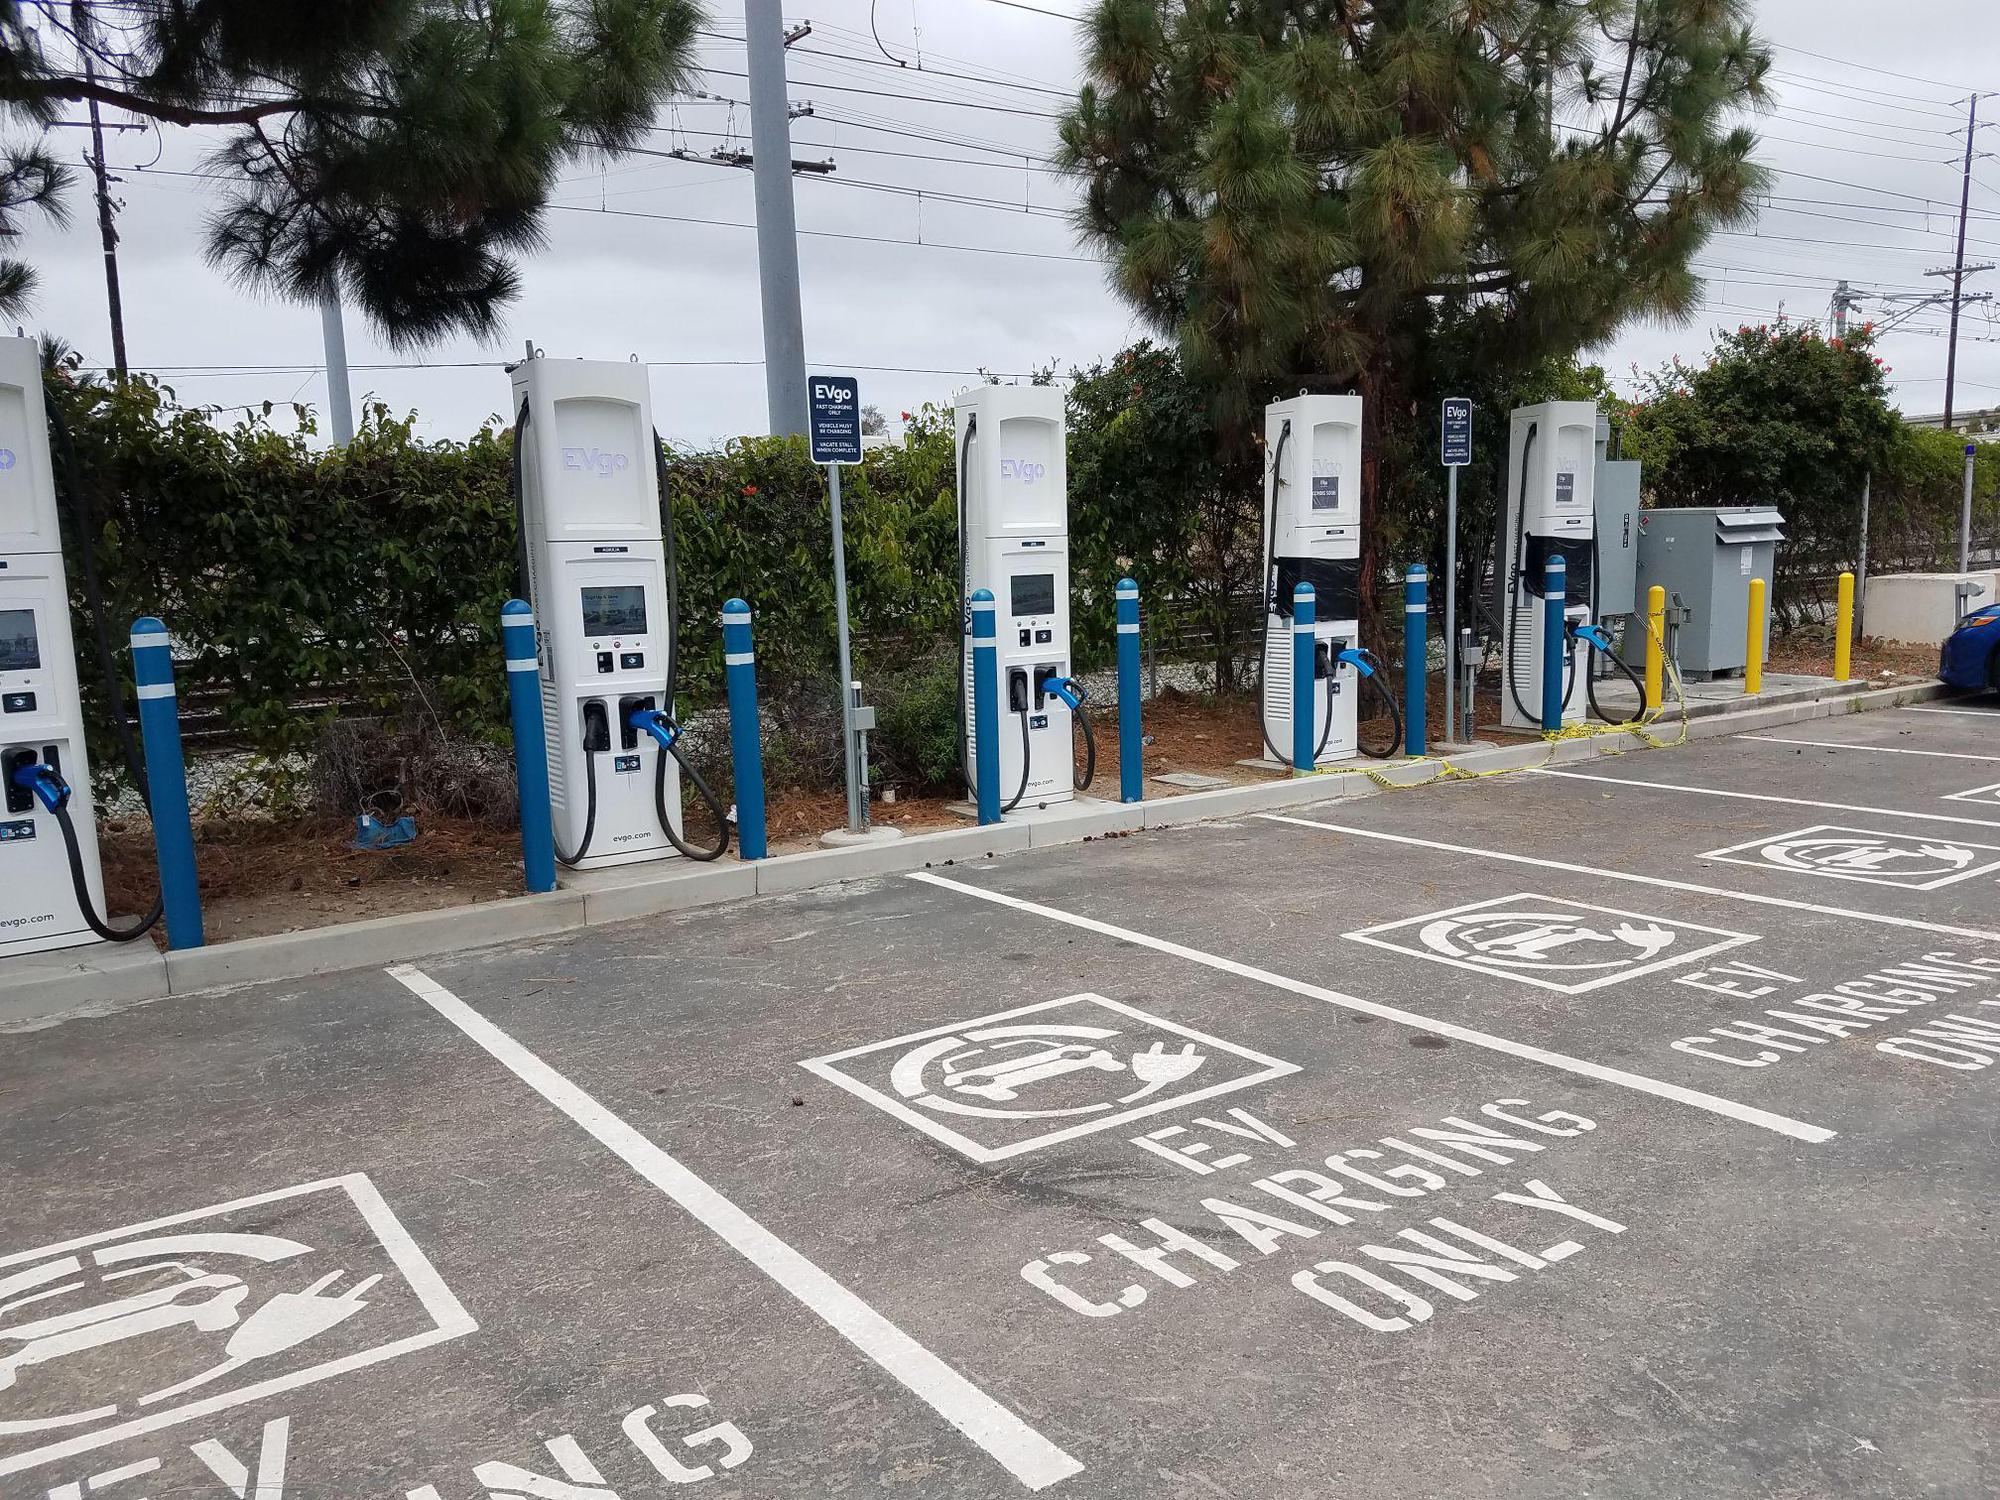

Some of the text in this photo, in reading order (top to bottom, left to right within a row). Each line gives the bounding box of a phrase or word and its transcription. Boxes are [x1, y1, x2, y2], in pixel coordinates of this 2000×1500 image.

[815, 384, 852, 403] EVgo
[1447, 406, 1467, 419] EVgo
[562, 447, 629, 479] EVgo
[1000, 459, 1045, 484] EVgo
[964, 596, 972, 636] EVgo
[536, 620, 544, 667] EVgo
[1027, 779, 1055, 788] evgo.com
[613, 831, 651, 842] evgo.com
[0, 914, 54, 928] evgo.com
[1671, 961, 1804, 999] EV
[1670, 951, 2000, 1067] CHARGING
[1128, 1107, 1298, 1176] EV
[1020, 1098, 1597, 1318] CHARGING
[1291, 1179, 1629, 1332] ONLY
